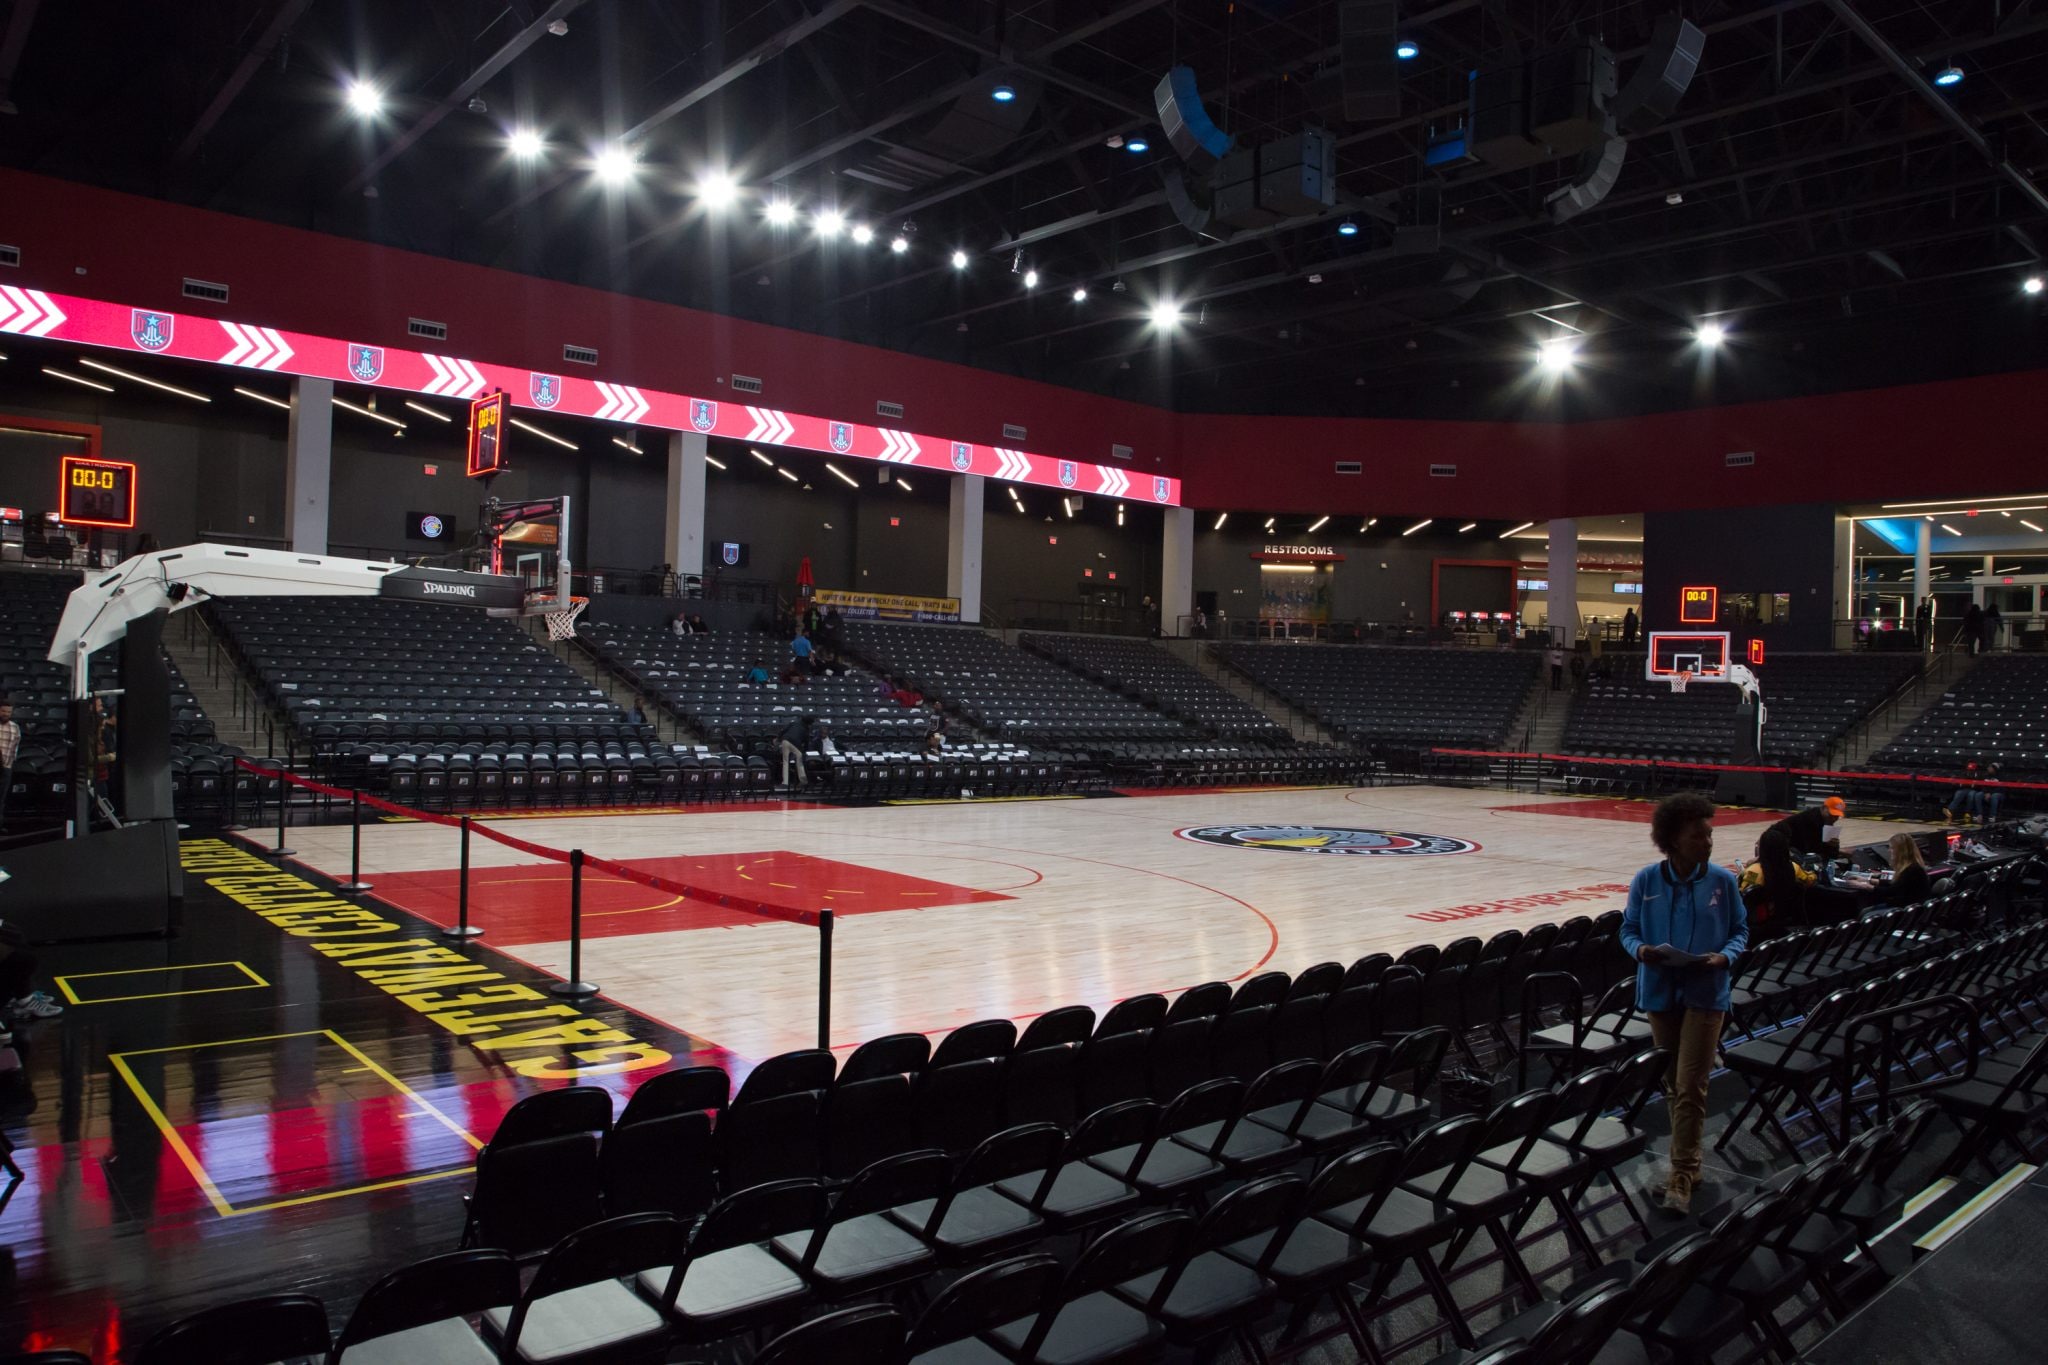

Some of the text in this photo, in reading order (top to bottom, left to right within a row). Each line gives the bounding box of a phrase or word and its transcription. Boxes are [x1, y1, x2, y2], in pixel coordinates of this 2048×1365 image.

[72, 468, 113, 489] 00.0
[1264, 545, 1334, 555] RESTROOMS
[423, 582, 476, 598] SPALDING
[204, 873, 401, 938] CENTER
[310, 938, 672, 1080] GATEWAY
